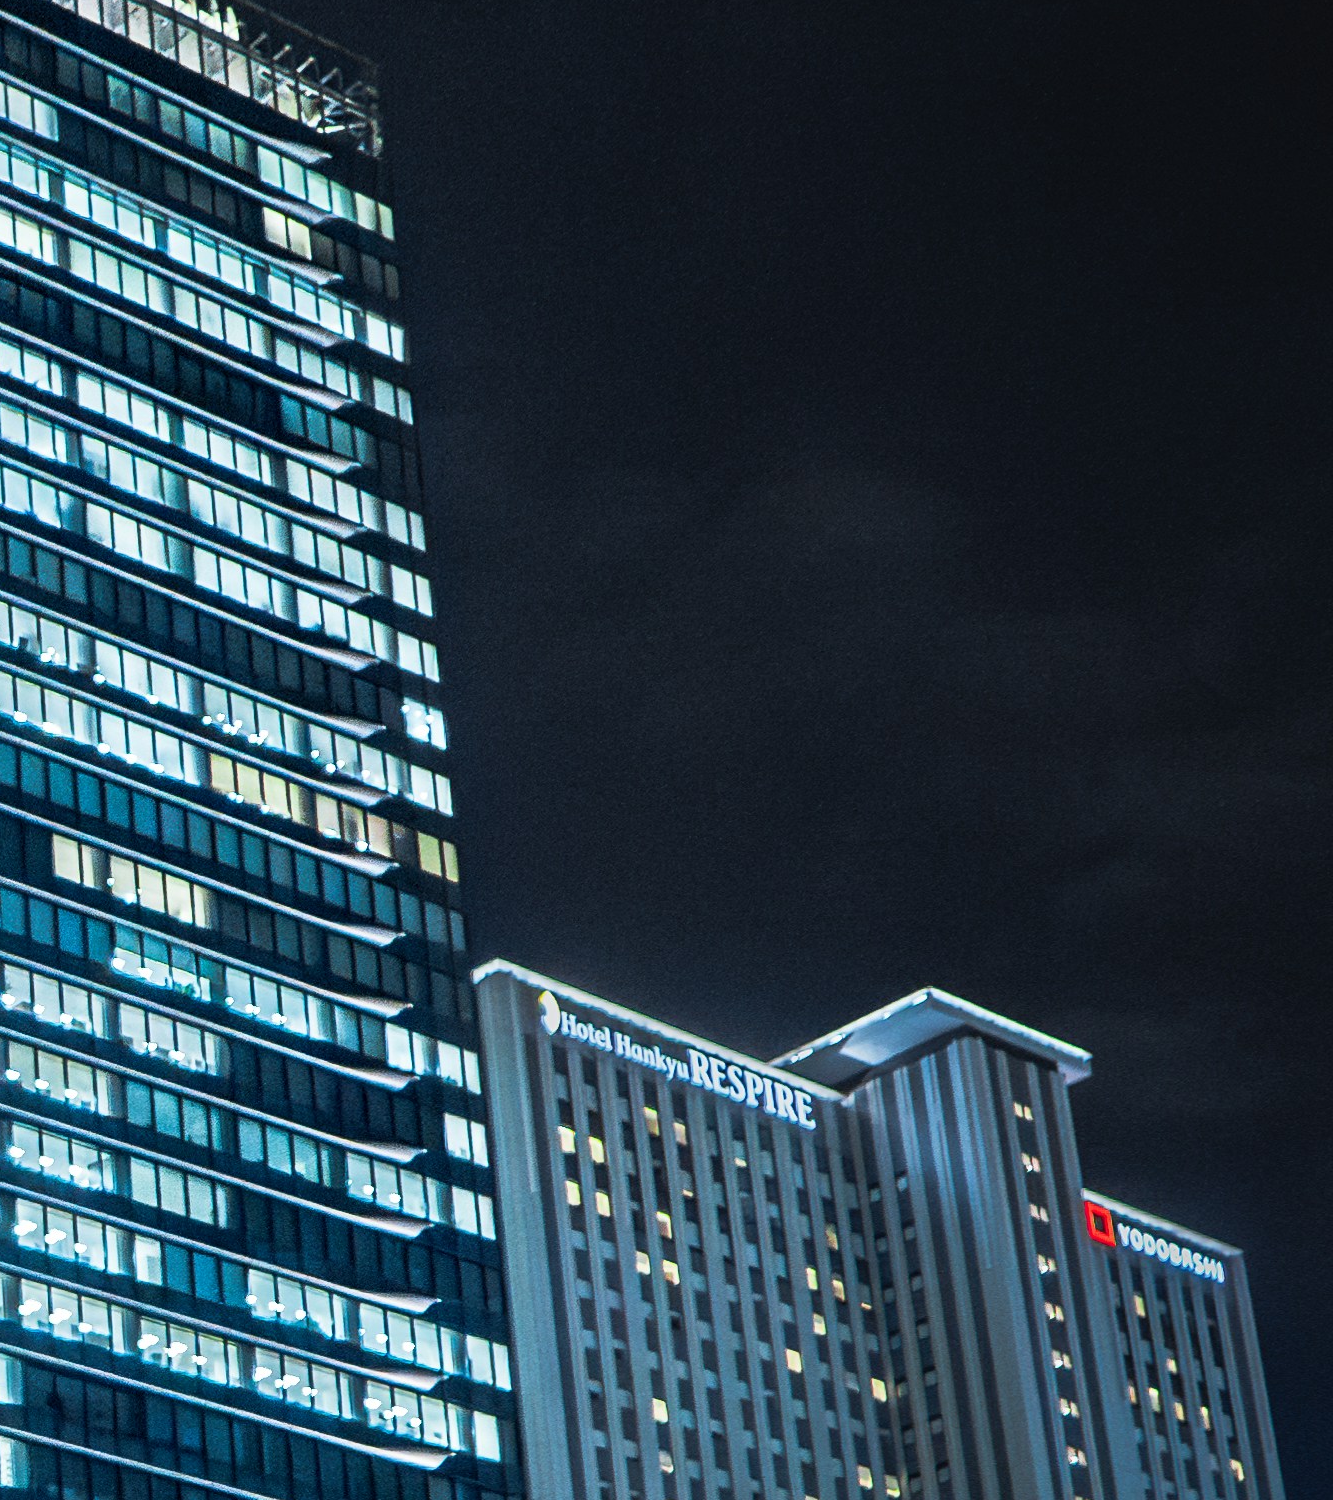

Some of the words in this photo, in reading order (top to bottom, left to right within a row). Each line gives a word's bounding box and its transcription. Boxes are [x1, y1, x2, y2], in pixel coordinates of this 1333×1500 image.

[560, 1010, 613, 1052] Hotel
[614, 1031, 690, 1080] Hankyu
[686, 1048, 817, 1130] RESPIRE
[1117, 1222, 1225, 1283] YODOBASHI
